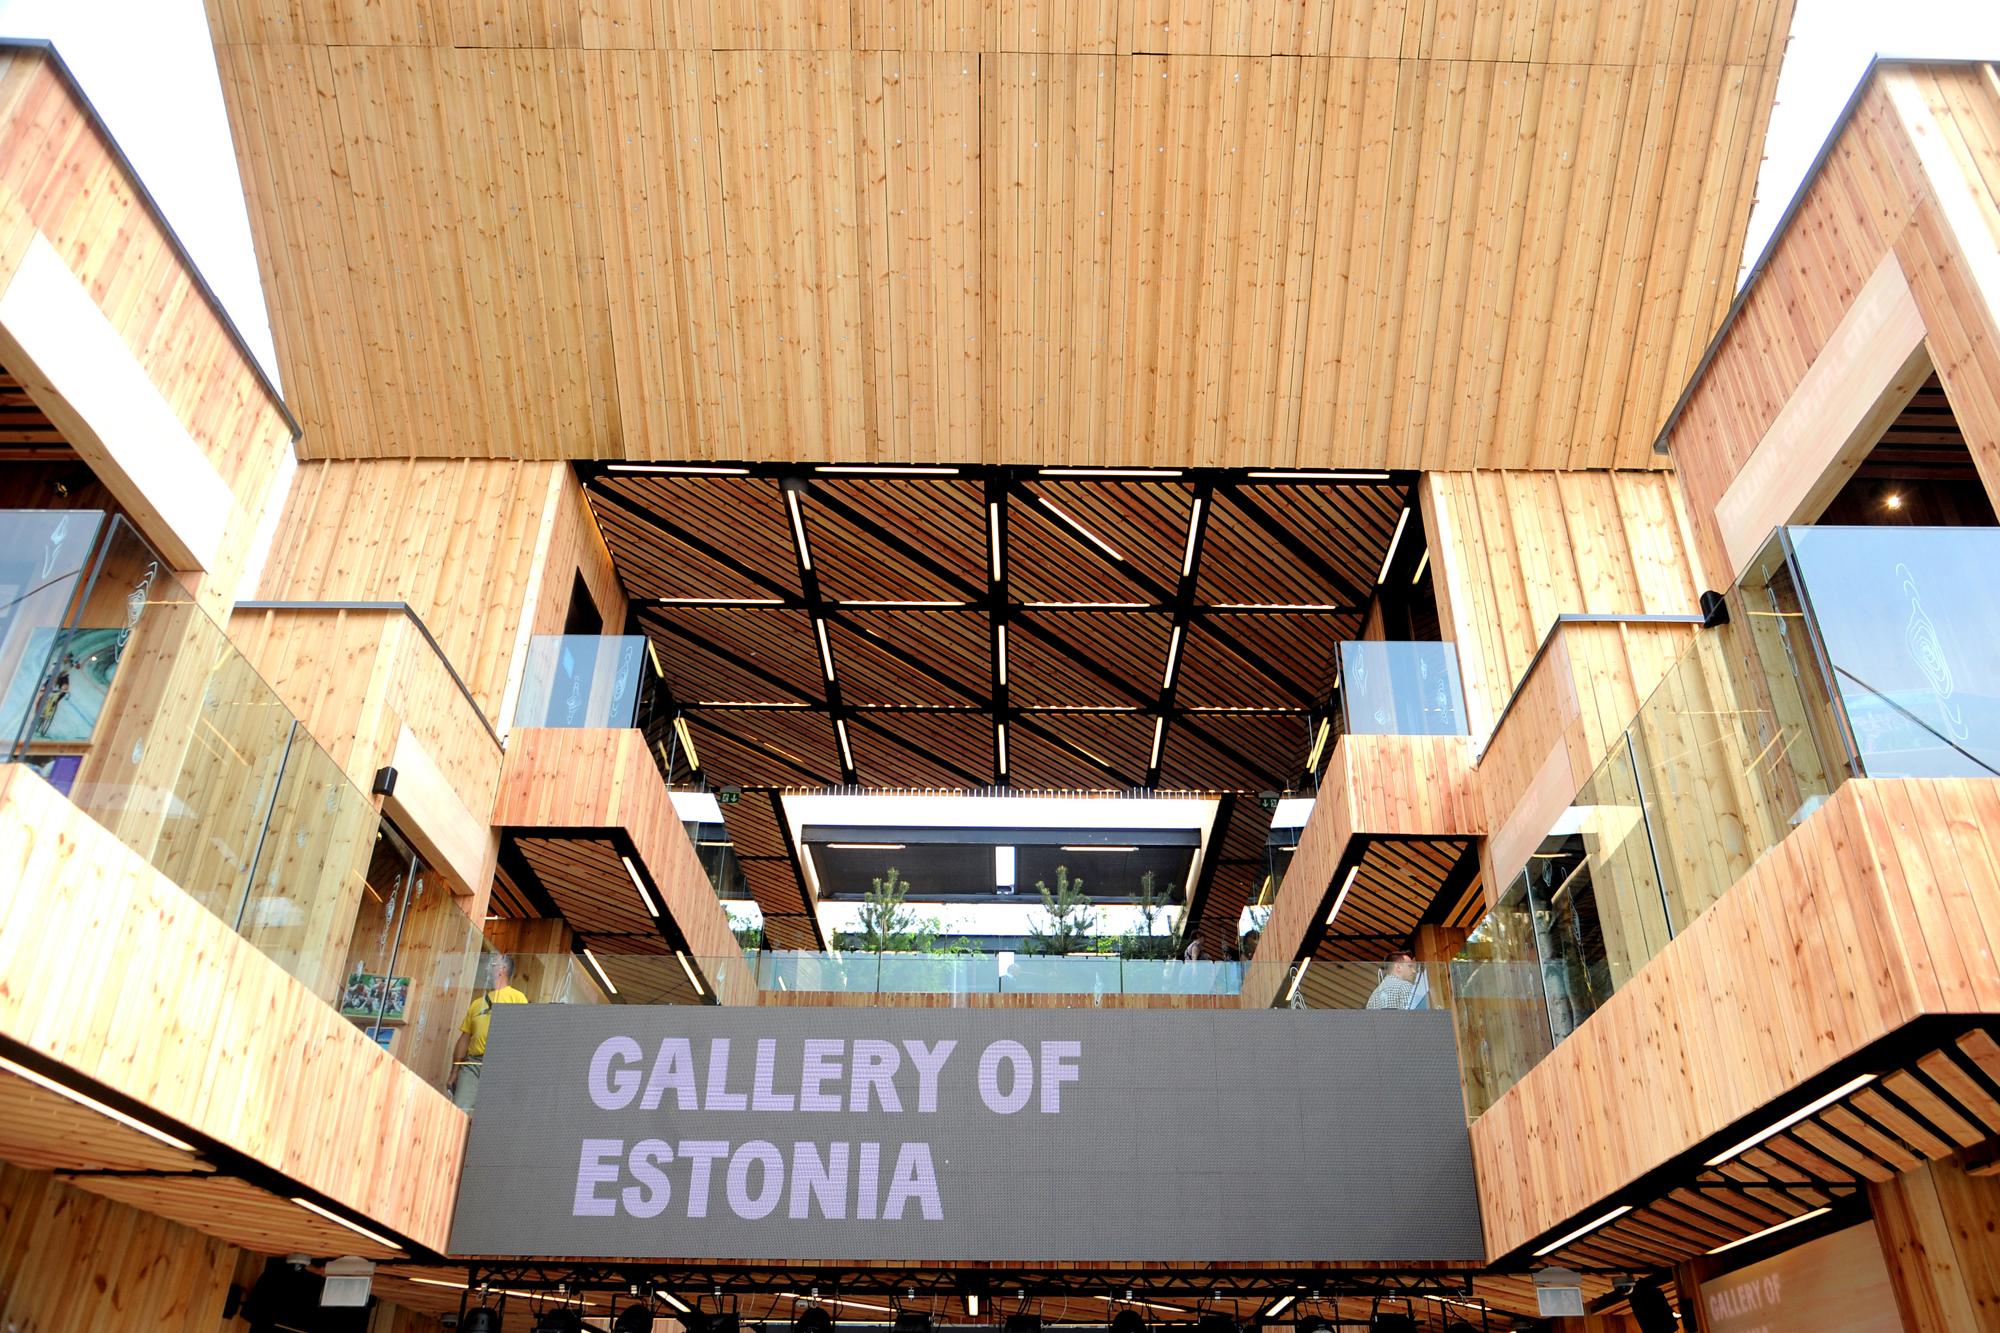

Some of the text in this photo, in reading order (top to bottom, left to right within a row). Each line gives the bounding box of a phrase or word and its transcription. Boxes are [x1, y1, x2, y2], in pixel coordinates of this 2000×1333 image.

[588, 1035, 1081, 1113] GALLERY OF
[572, 1138, 944, 1220] ESTONIA
[1710, 1273, 1781, 1322] GALLERY OF
